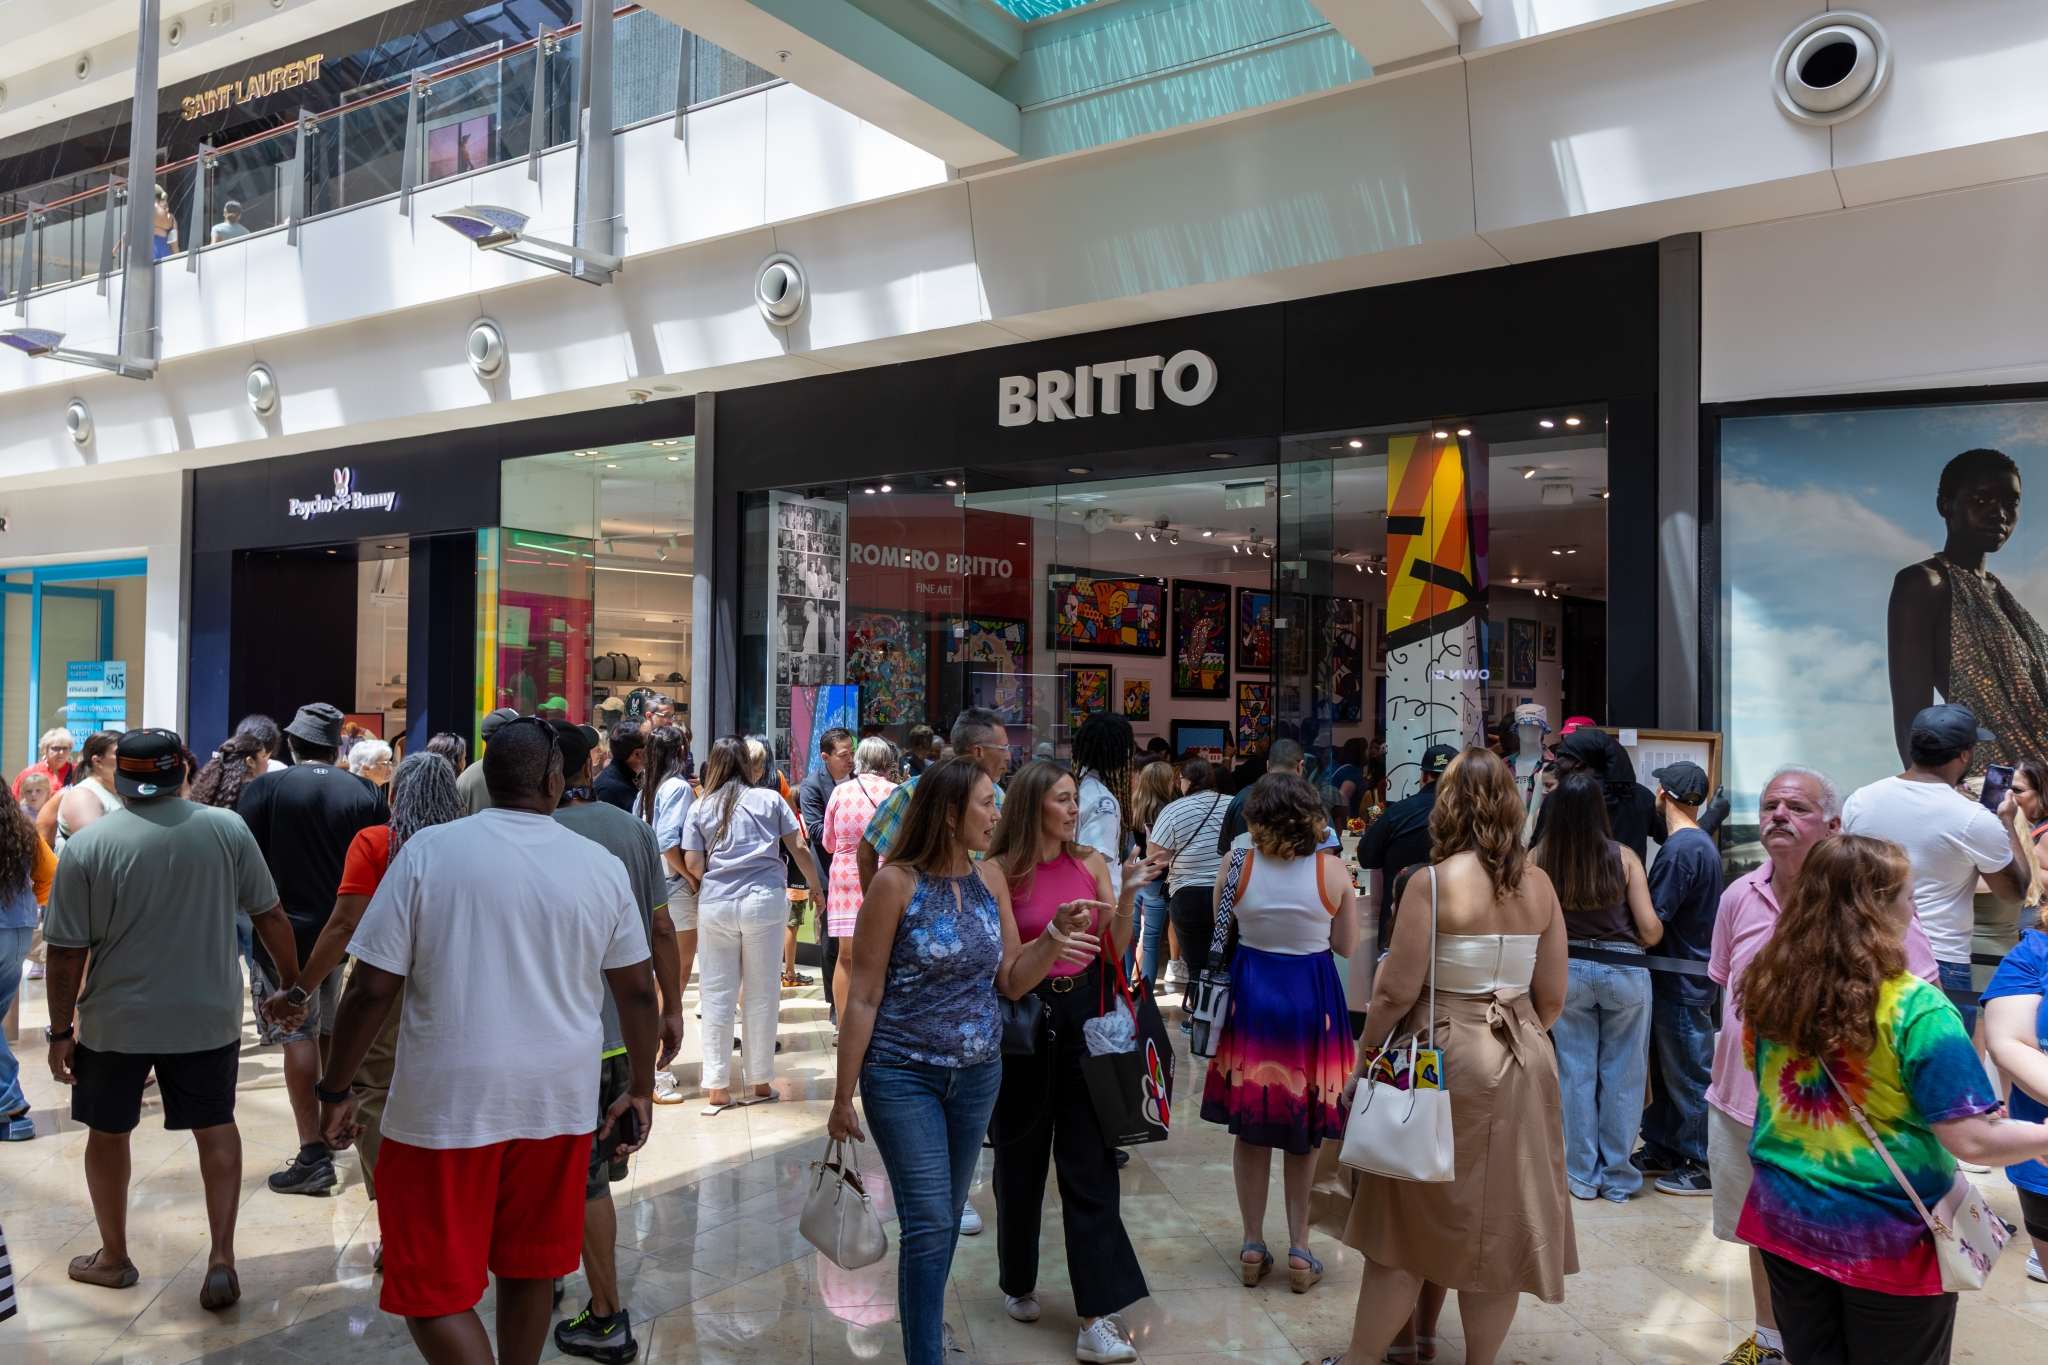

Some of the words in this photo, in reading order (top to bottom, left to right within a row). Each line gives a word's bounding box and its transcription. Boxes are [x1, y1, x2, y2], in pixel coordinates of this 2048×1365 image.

[182, 84, 233, 121] SAINT
[235, 54, 324, 105] LAURENT
[998, 349, 1218, 427] BRITTO
[288, 493, 333, 520] Psycho
[351, 491, 396, 512] Bunny
[849, 542, 940, 572] ROMERO
[946, 553, 1013, 579] BRITTO
[915, 582, 935, 594] FINE
[937, 584, 953, 595] ART
[105, 673, 124, 690] $95
